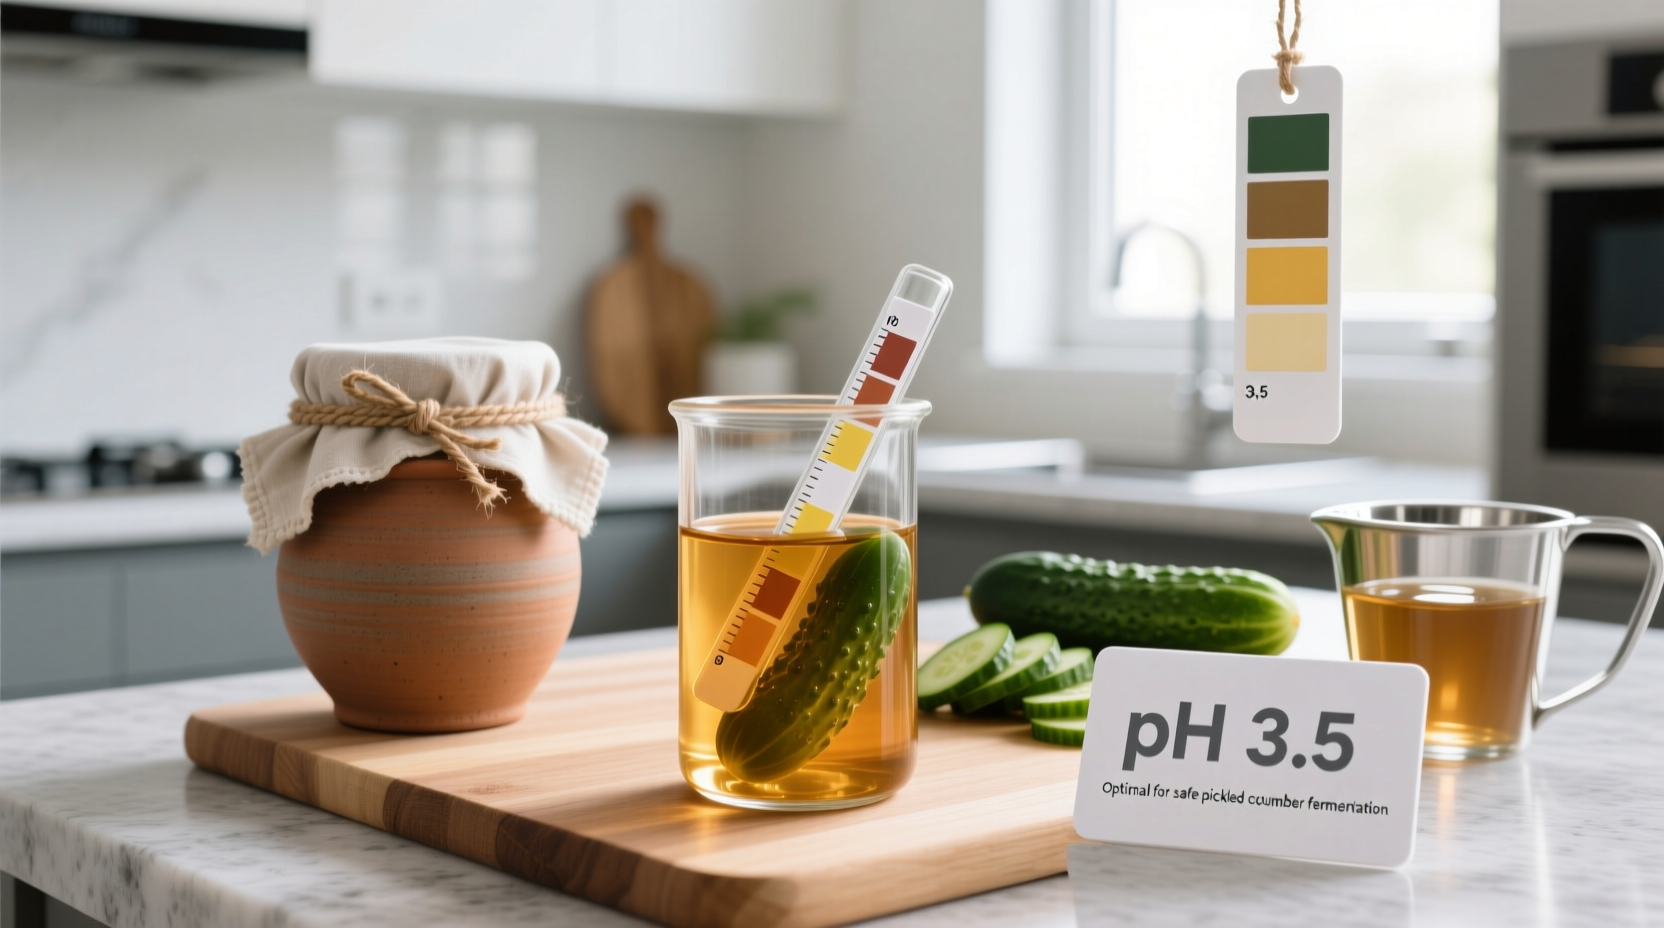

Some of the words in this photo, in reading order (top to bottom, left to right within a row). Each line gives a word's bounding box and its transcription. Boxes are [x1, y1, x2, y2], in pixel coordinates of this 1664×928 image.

[1121, 701, 1227, 772] pH
[1246, 707, 1355, 772] 3.5
[1102, 781, 1151, 798] Optimal
[1153, 783, 1170, 797] for
[1173, 786, 1199, 800] safe
[1201, 788, 1245, 804] pickled
